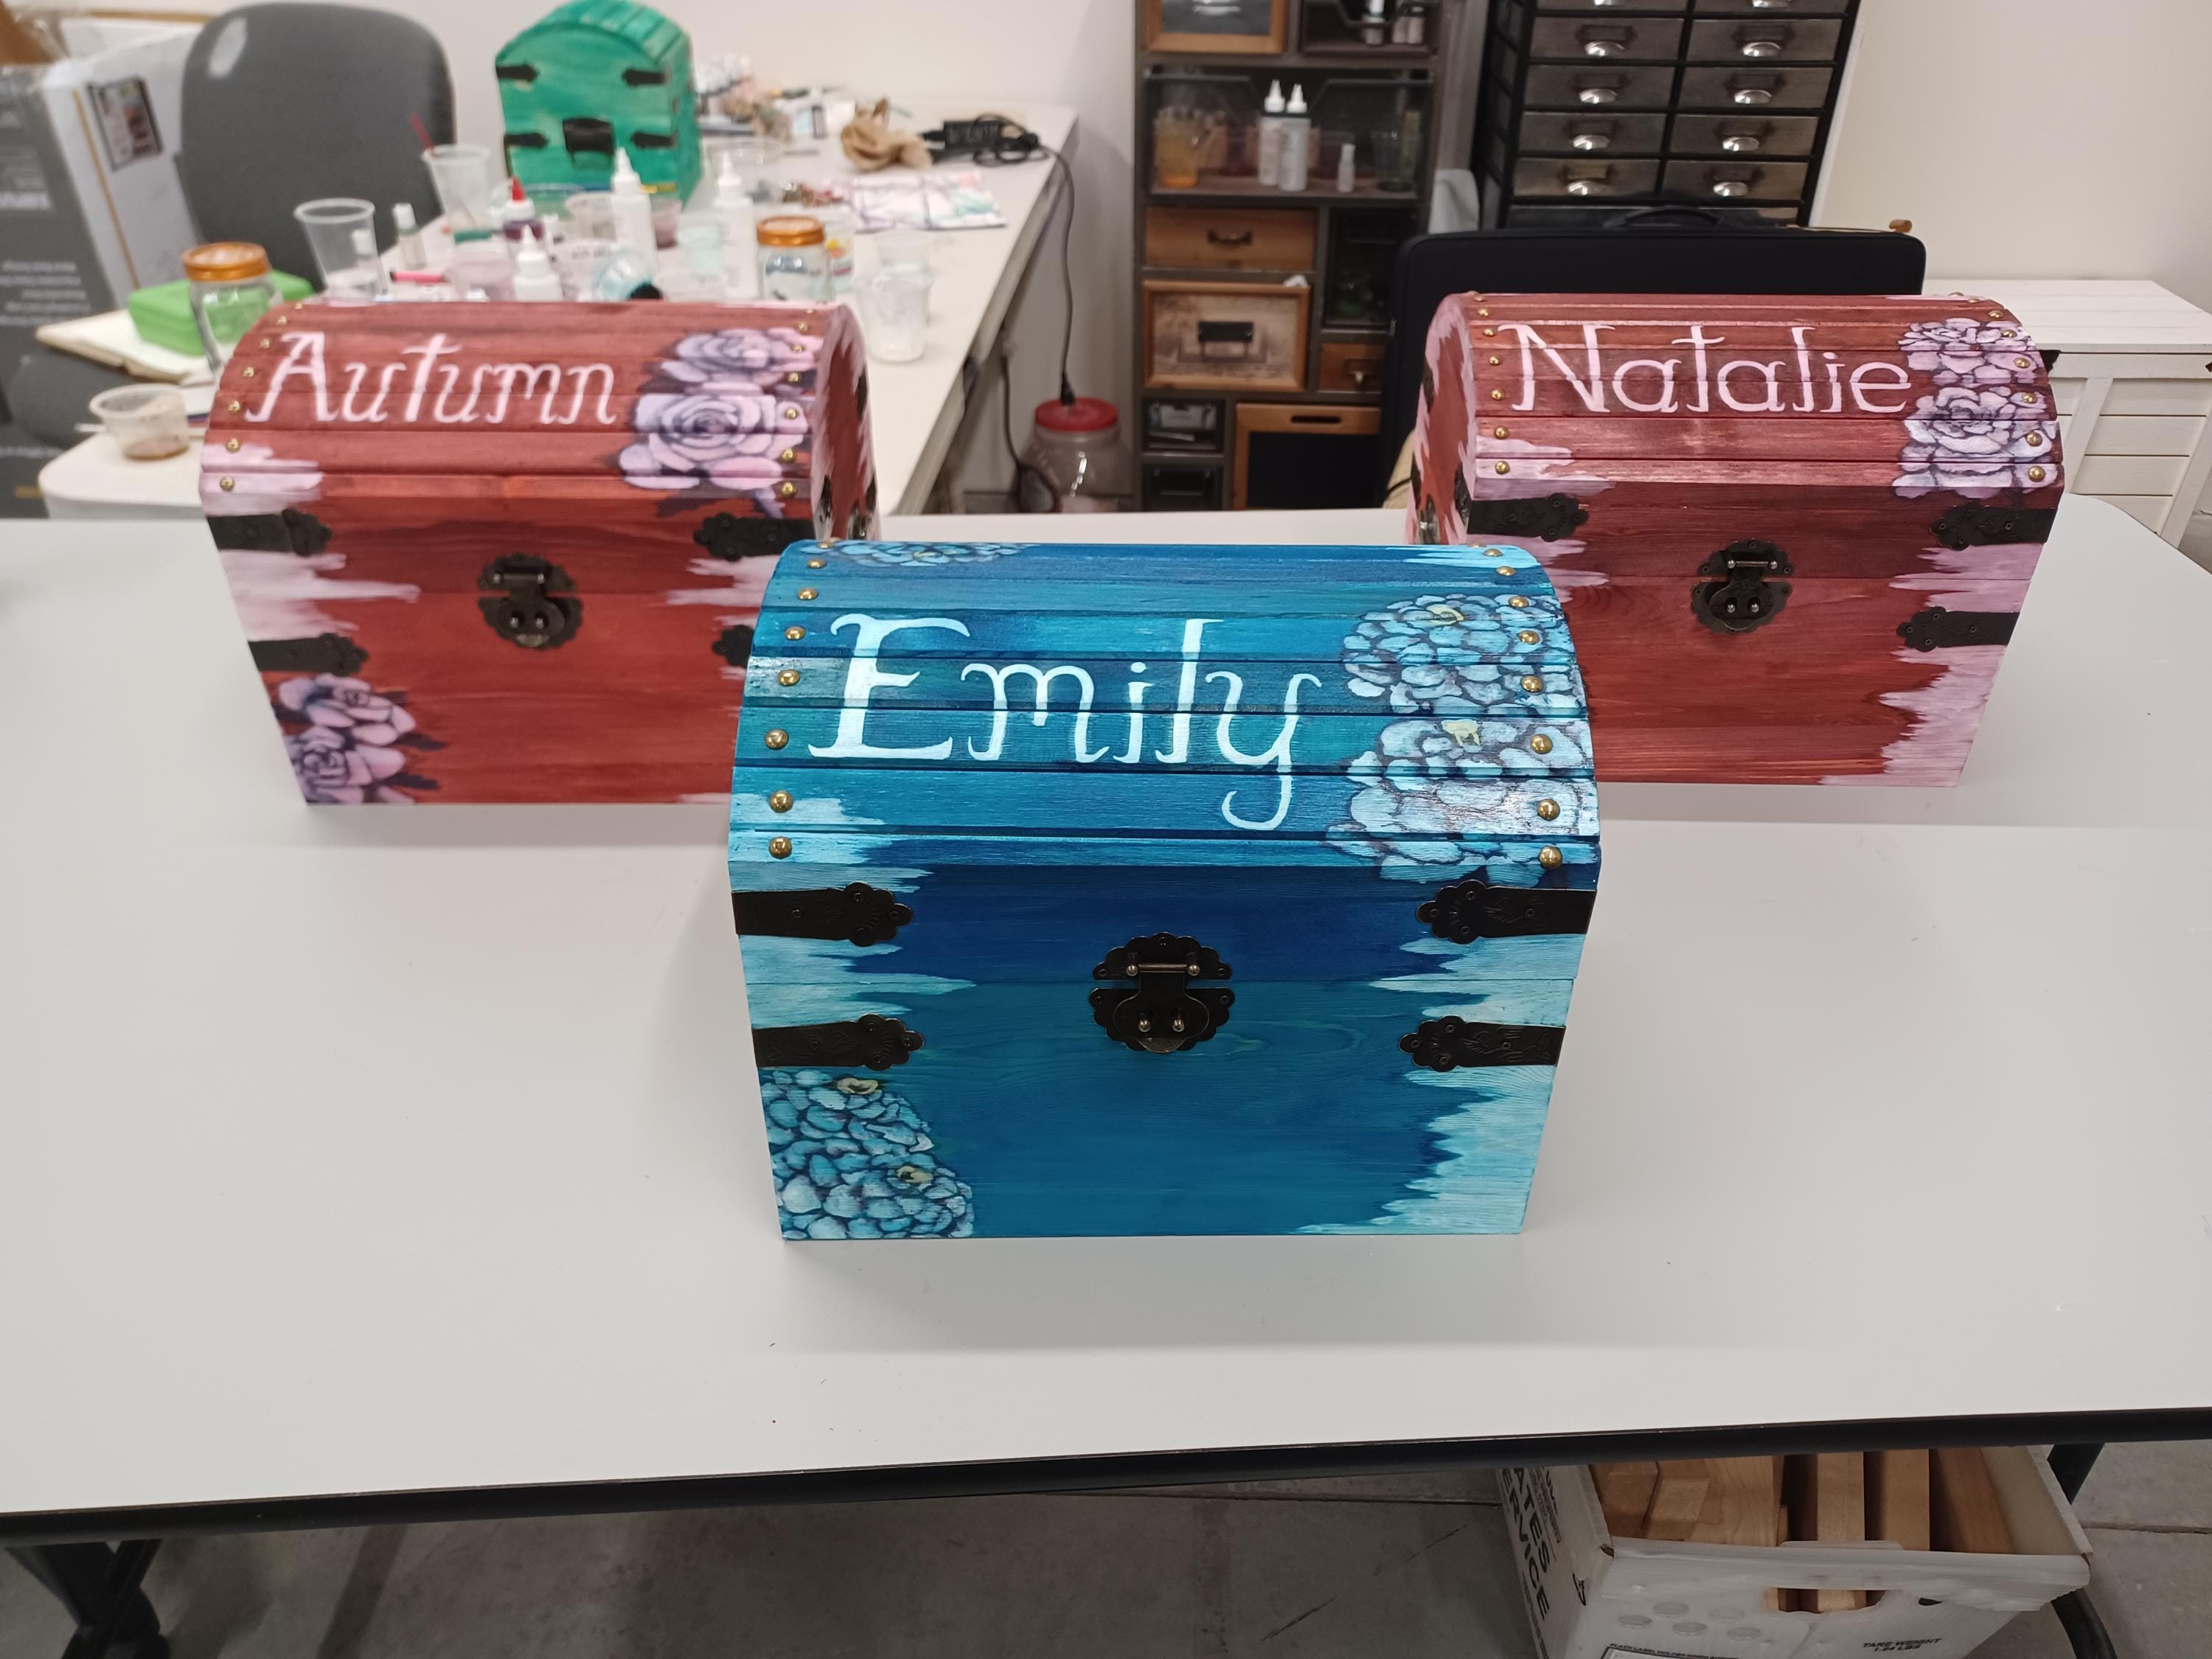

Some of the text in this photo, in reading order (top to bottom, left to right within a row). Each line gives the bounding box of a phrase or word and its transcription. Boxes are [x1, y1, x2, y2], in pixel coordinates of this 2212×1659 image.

[244, 331, 617, 425] Autumn
[1498, 324, 1912, 414] Natalie
[808, 613, 1322, 830] Emily
